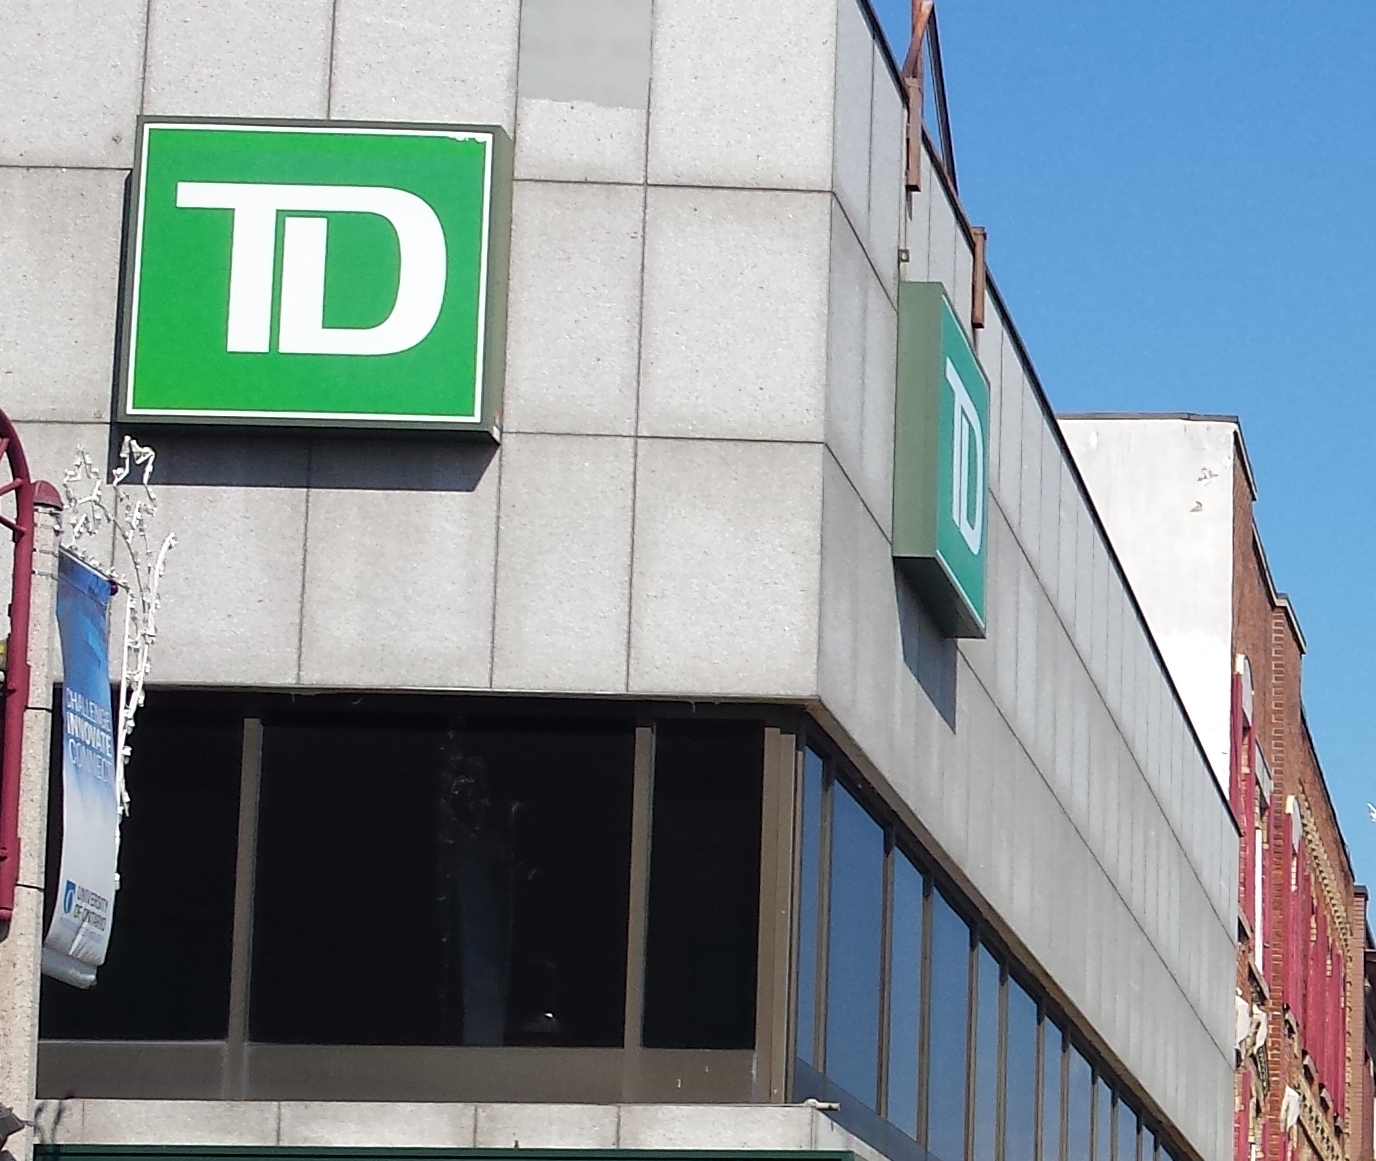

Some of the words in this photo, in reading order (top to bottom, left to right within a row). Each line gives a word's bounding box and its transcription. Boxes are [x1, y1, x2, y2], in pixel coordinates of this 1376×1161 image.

[175, 181, 448, 358] TD
[945, 356, 985, 555] TD
[66, 714, 113, 758] INNOVATE
[68, 738, 113, 782] CONNECT
